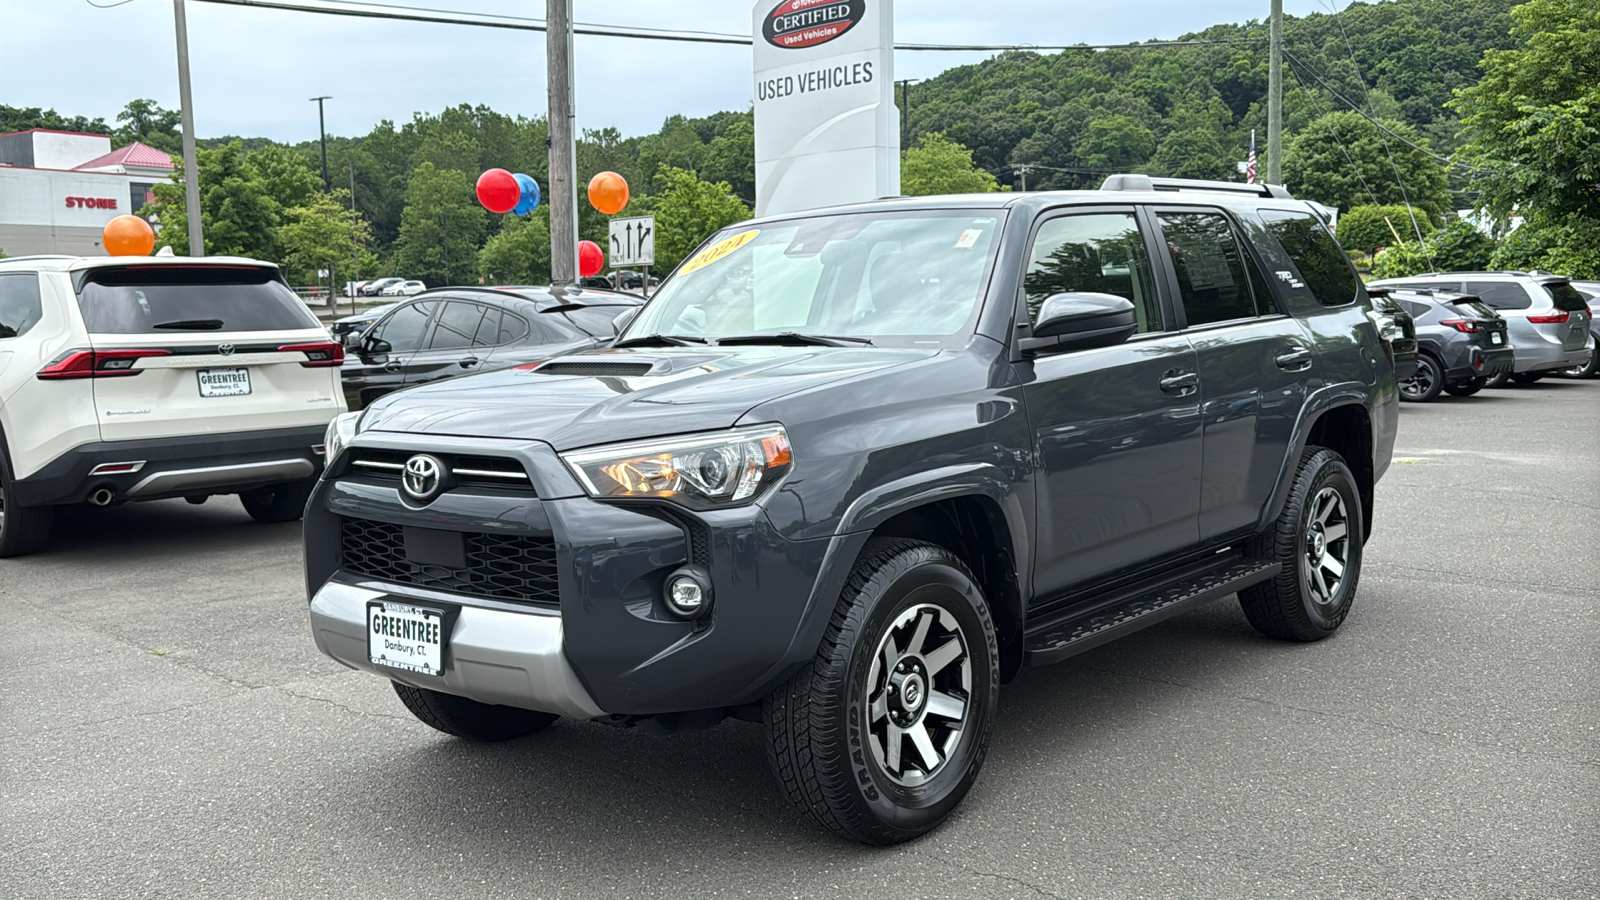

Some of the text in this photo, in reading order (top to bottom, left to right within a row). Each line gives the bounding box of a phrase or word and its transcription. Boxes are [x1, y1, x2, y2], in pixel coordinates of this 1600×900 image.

[773, 5, 850, 33] CERTIFIED
[784, 26, 837, 45] Used Vehicles
[758, 61, 873, 101] USED VEHICLES
[65, 196, 117, 210] STONE
[689, 234, 746, 270] 2024
[201, 373, 247, 385] GREENTREE
[373, 614, 438, 645] GREENTREE
[384, 639, 415, 656] Danbury,
[371, 657, 438, 676] GREENTREE
